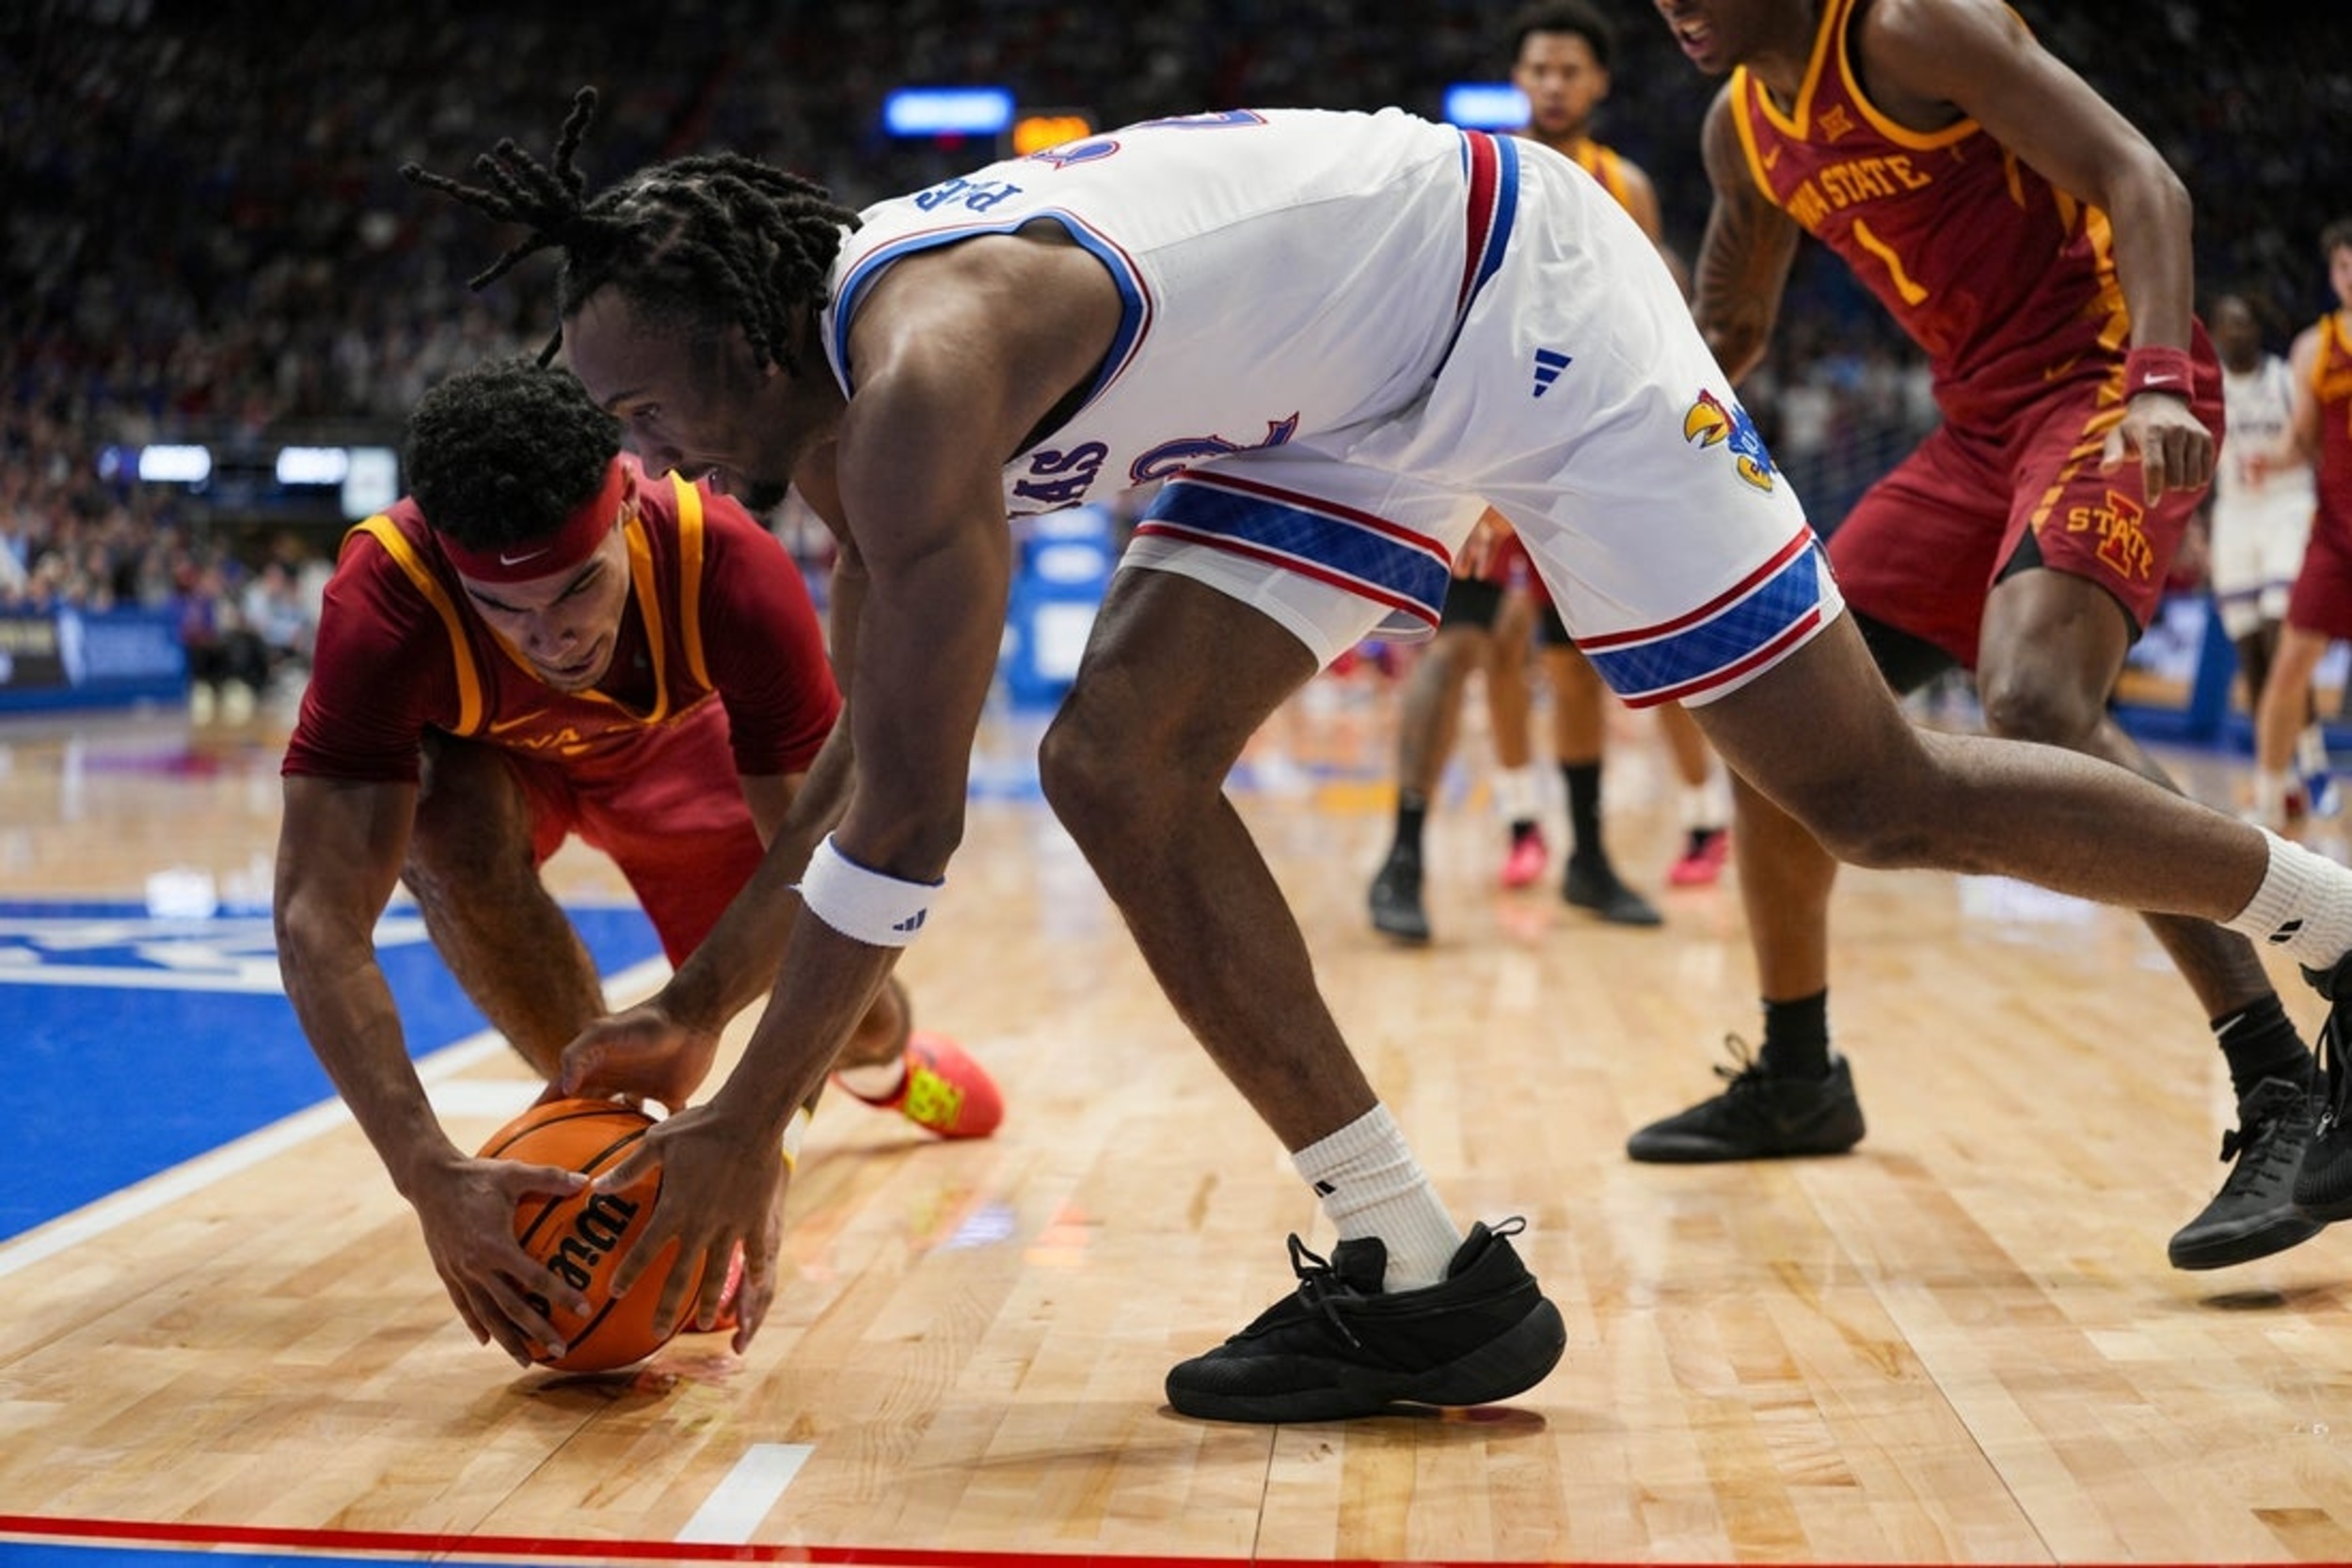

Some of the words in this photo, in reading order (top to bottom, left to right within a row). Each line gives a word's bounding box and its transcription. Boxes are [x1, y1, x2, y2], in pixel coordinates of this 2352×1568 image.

[1820, 154, 1932, 208] STATE
[1852, 217, 1929, 307] 1
[1007, 442, 1109, 517] AS
